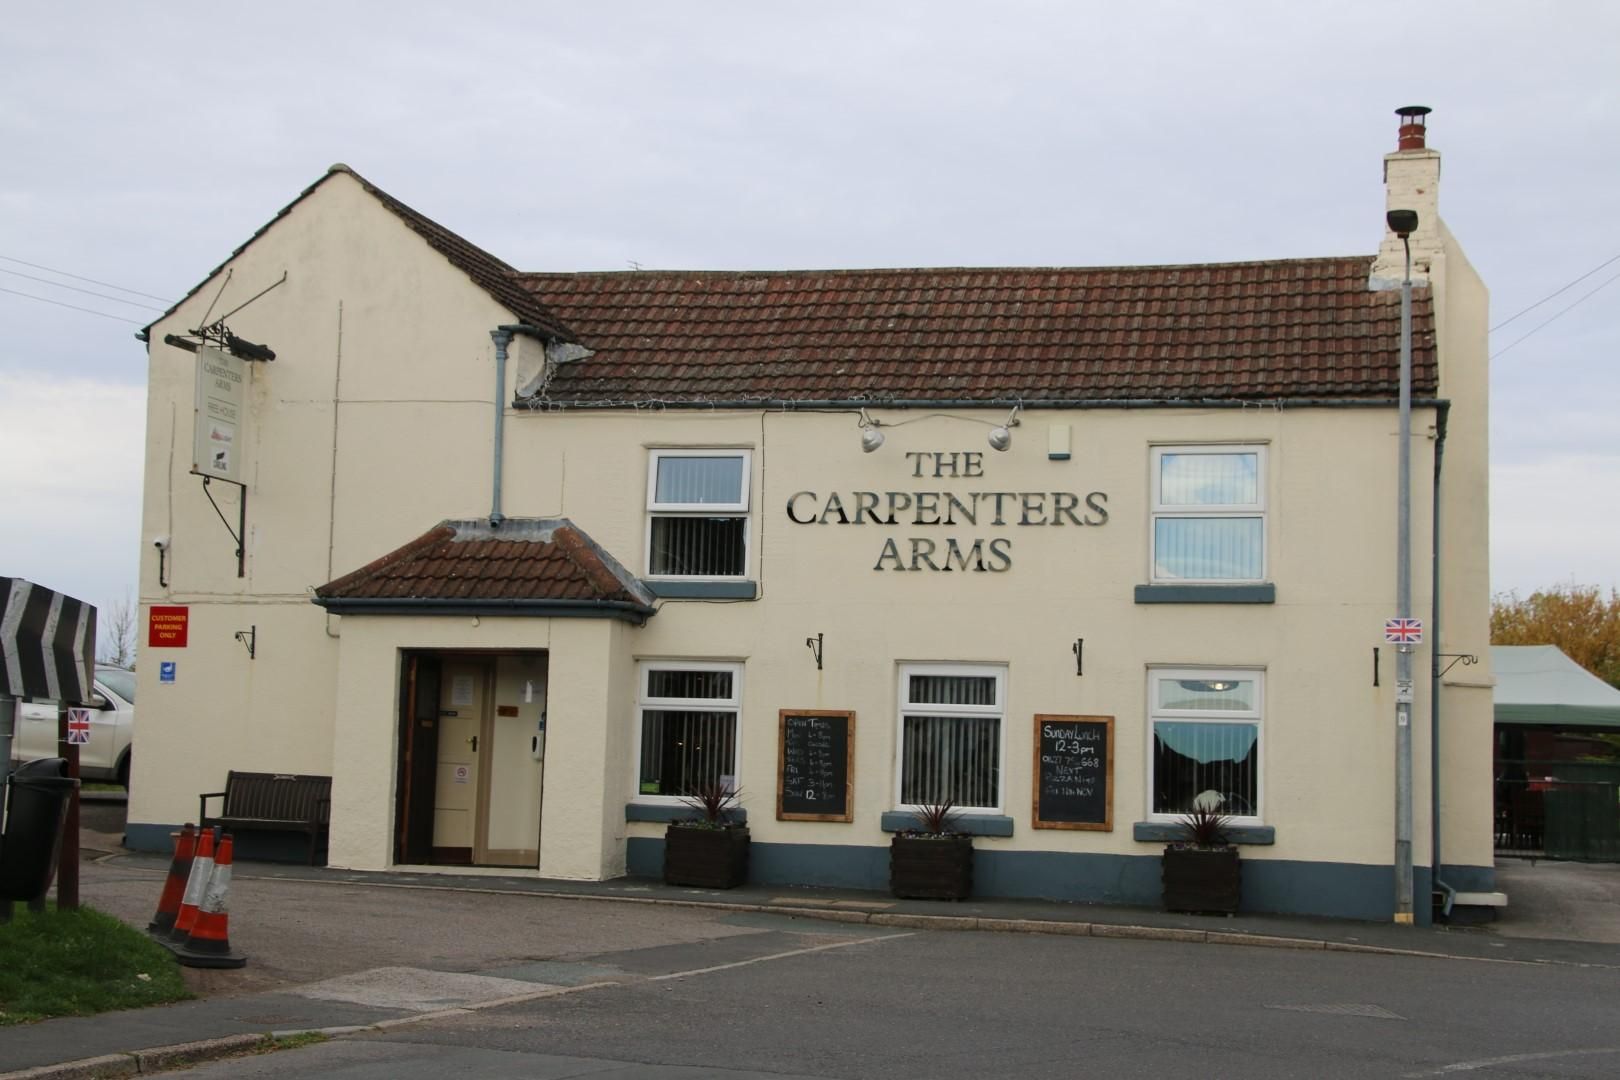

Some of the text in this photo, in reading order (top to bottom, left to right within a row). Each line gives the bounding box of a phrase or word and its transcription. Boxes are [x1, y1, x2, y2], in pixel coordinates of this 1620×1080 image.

[204, 363, 242, 383] CARPENTERS
[906, 452, 985, 478] THE
[786, 491, 1110, 526] CARPENTERS
[873, 538, 1012, 572] ARMS
